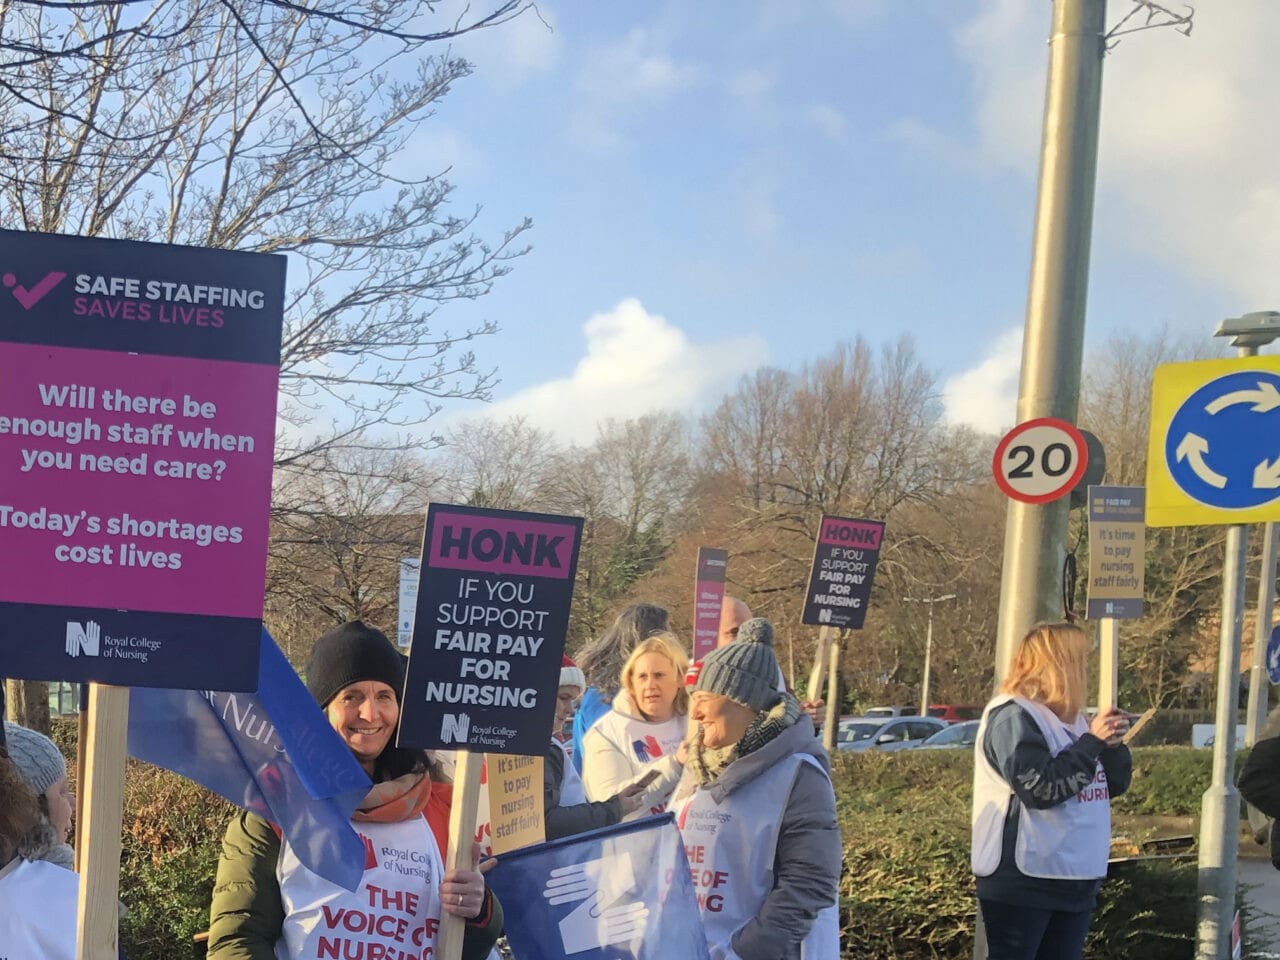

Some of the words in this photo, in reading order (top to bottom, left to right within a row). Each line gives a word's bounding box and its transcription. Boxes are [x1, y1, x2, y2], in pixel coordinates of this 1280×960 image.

[75, 274, 140, 299] SAFE
[145, 279, 265, 310] STAFFING
[73, 297, 152, 321] SAVES
[158, 305, 225, 328] LIVES
[38, 383, 95, 410] Will
[101, 388, 177, 415] there
[183, 395, 216, 418] be
[107, 420, 173, 446] staff
[177, 428, 255, 453] when
[20, 449, 72, 472] you
[79, 452, 148, 475] need
[153, 459, 226, 481] care?
[1008, 443, 1072, 479] 20
[107, 513, 243, 545] shortages
[825, 524, 877, 545] HONK
[1115, 528, 1136, 540] time
[54, 543, 113, 565] cost
[119, 543, 183, 570] lives
[439, 525, 566, 569] HONK
[830, 547, 841, 558] IF
[842, 549, 864, 561] YOU
[1115, 546, 1131, 559] pay
[821, 558, 869, 573] SUPPORT
[1101, 560, 1134, 573] nursing
[819, 570, 844, 582] FAIR
[844, 573, 866, 585] PAY
[1094, 576, 1116, 588] staff
[458, 578, 479, 600] IF
[485, 580, 535, 605] YOU
[828, 583, 851, 595] FOR
[813, 594, 861, 608] NURSING
[436, 603, 550, 632] SUPPORT
[104, 635, 128, 648] Royal
[130, 637, 162, 651] College
[434, 630, 493, 653] FAIR
[496, 634, 545, 657] PAY
[104, 648, 113, 658] of
[115, 648, 148, 663] Nursing
[459, 658, 512, 681] FOR
[425, 681, 538, 710] NURSING
[470, 735, 479, 744] of
[479, 735, 506, 749] Nursing
[472, 725, 492, 735] Royal
[492, 727, 518, 739] College
[497, 758, 513, 774] It's
[503, 780, 514, 793] to
[515, 775, 532, 793] pay
[501, 794, 535, 816] nursing
[496, 819, 517, 839] staff
[518, 812, 540, 832] fairly
[381, 847, 409, 861] Royal
[685, 845, 705, 863] HE
[384, 860, 393, 871] of
[395, 862, 432, 884] Nursing
[365, 883, 419, 917] THE
[321, 905, 409, 943] VOICE
